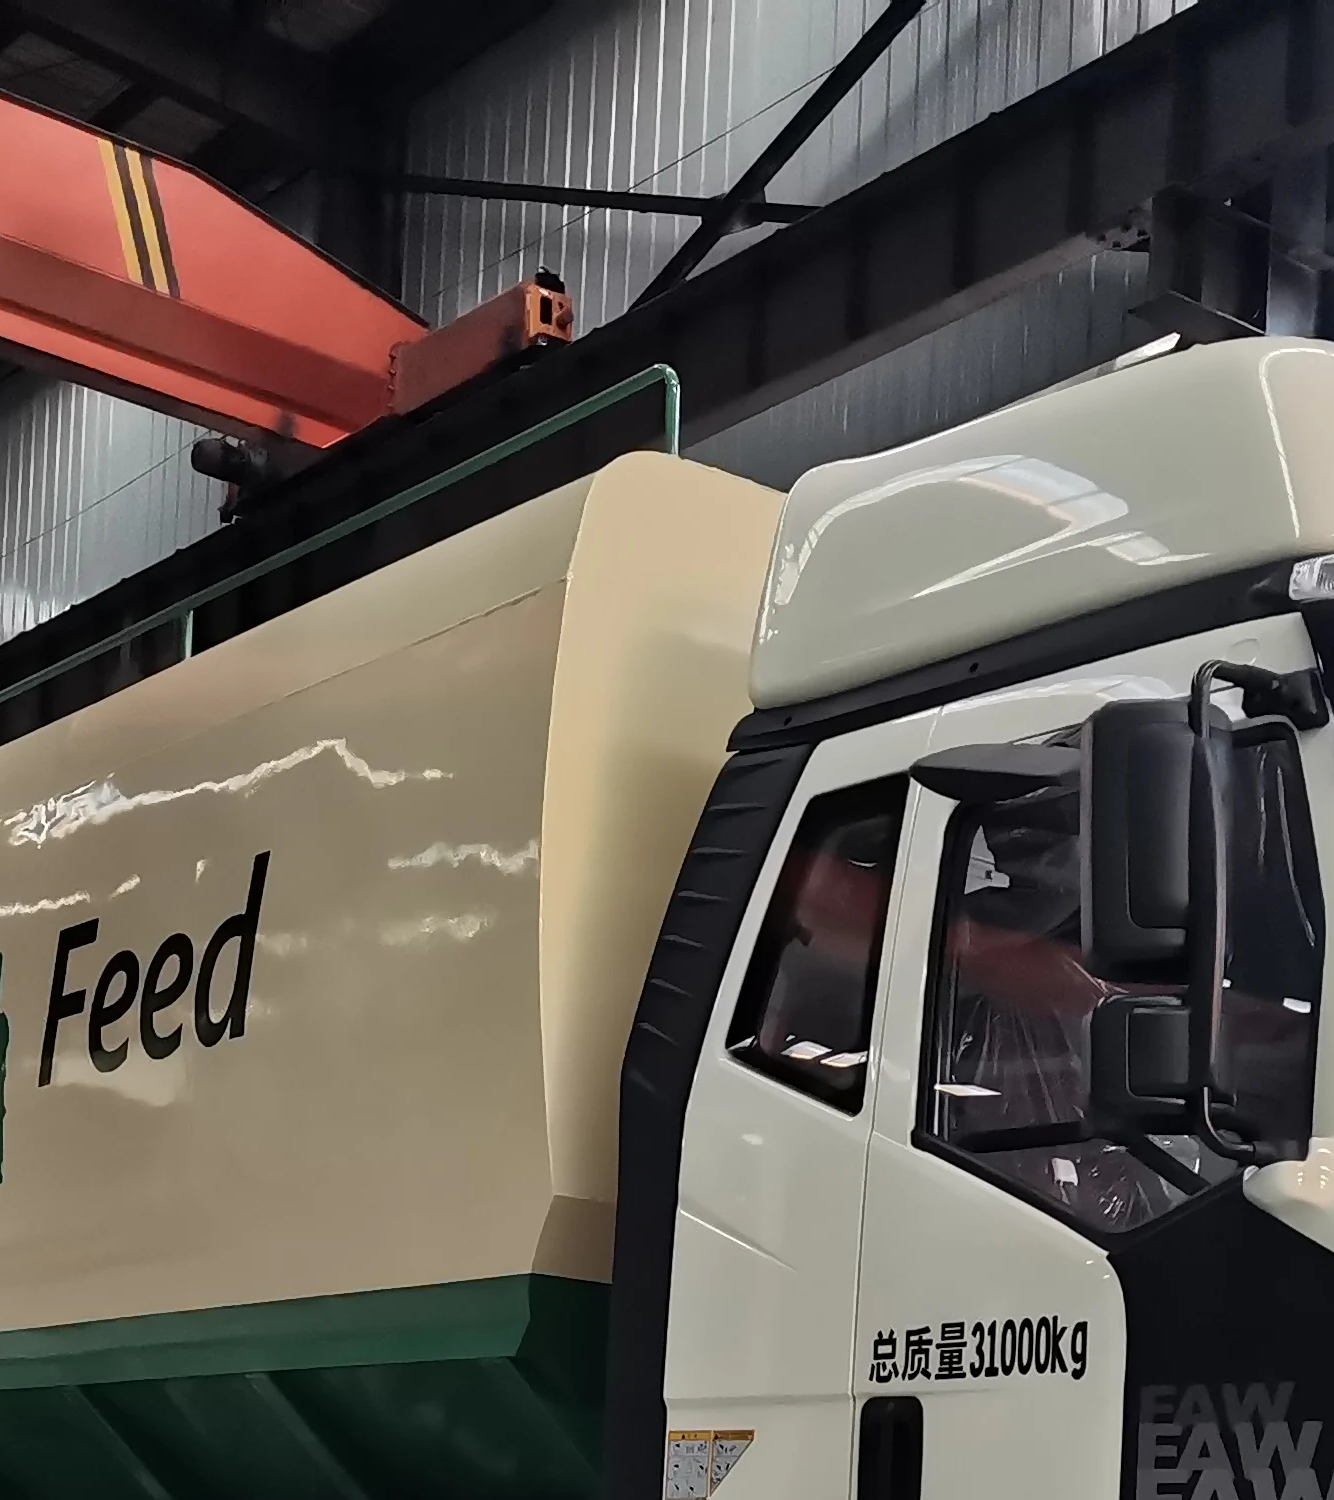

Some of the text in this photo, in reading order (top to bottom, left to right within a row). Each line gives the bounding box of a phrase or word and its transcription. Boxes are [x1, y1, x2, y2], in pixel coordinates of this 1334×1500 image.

[38, 850, 270, 1088] Feed
[868, 1315, 1088, 1383] 总质量31000kg
[1138, 1420, 1323, 1480] FAW
